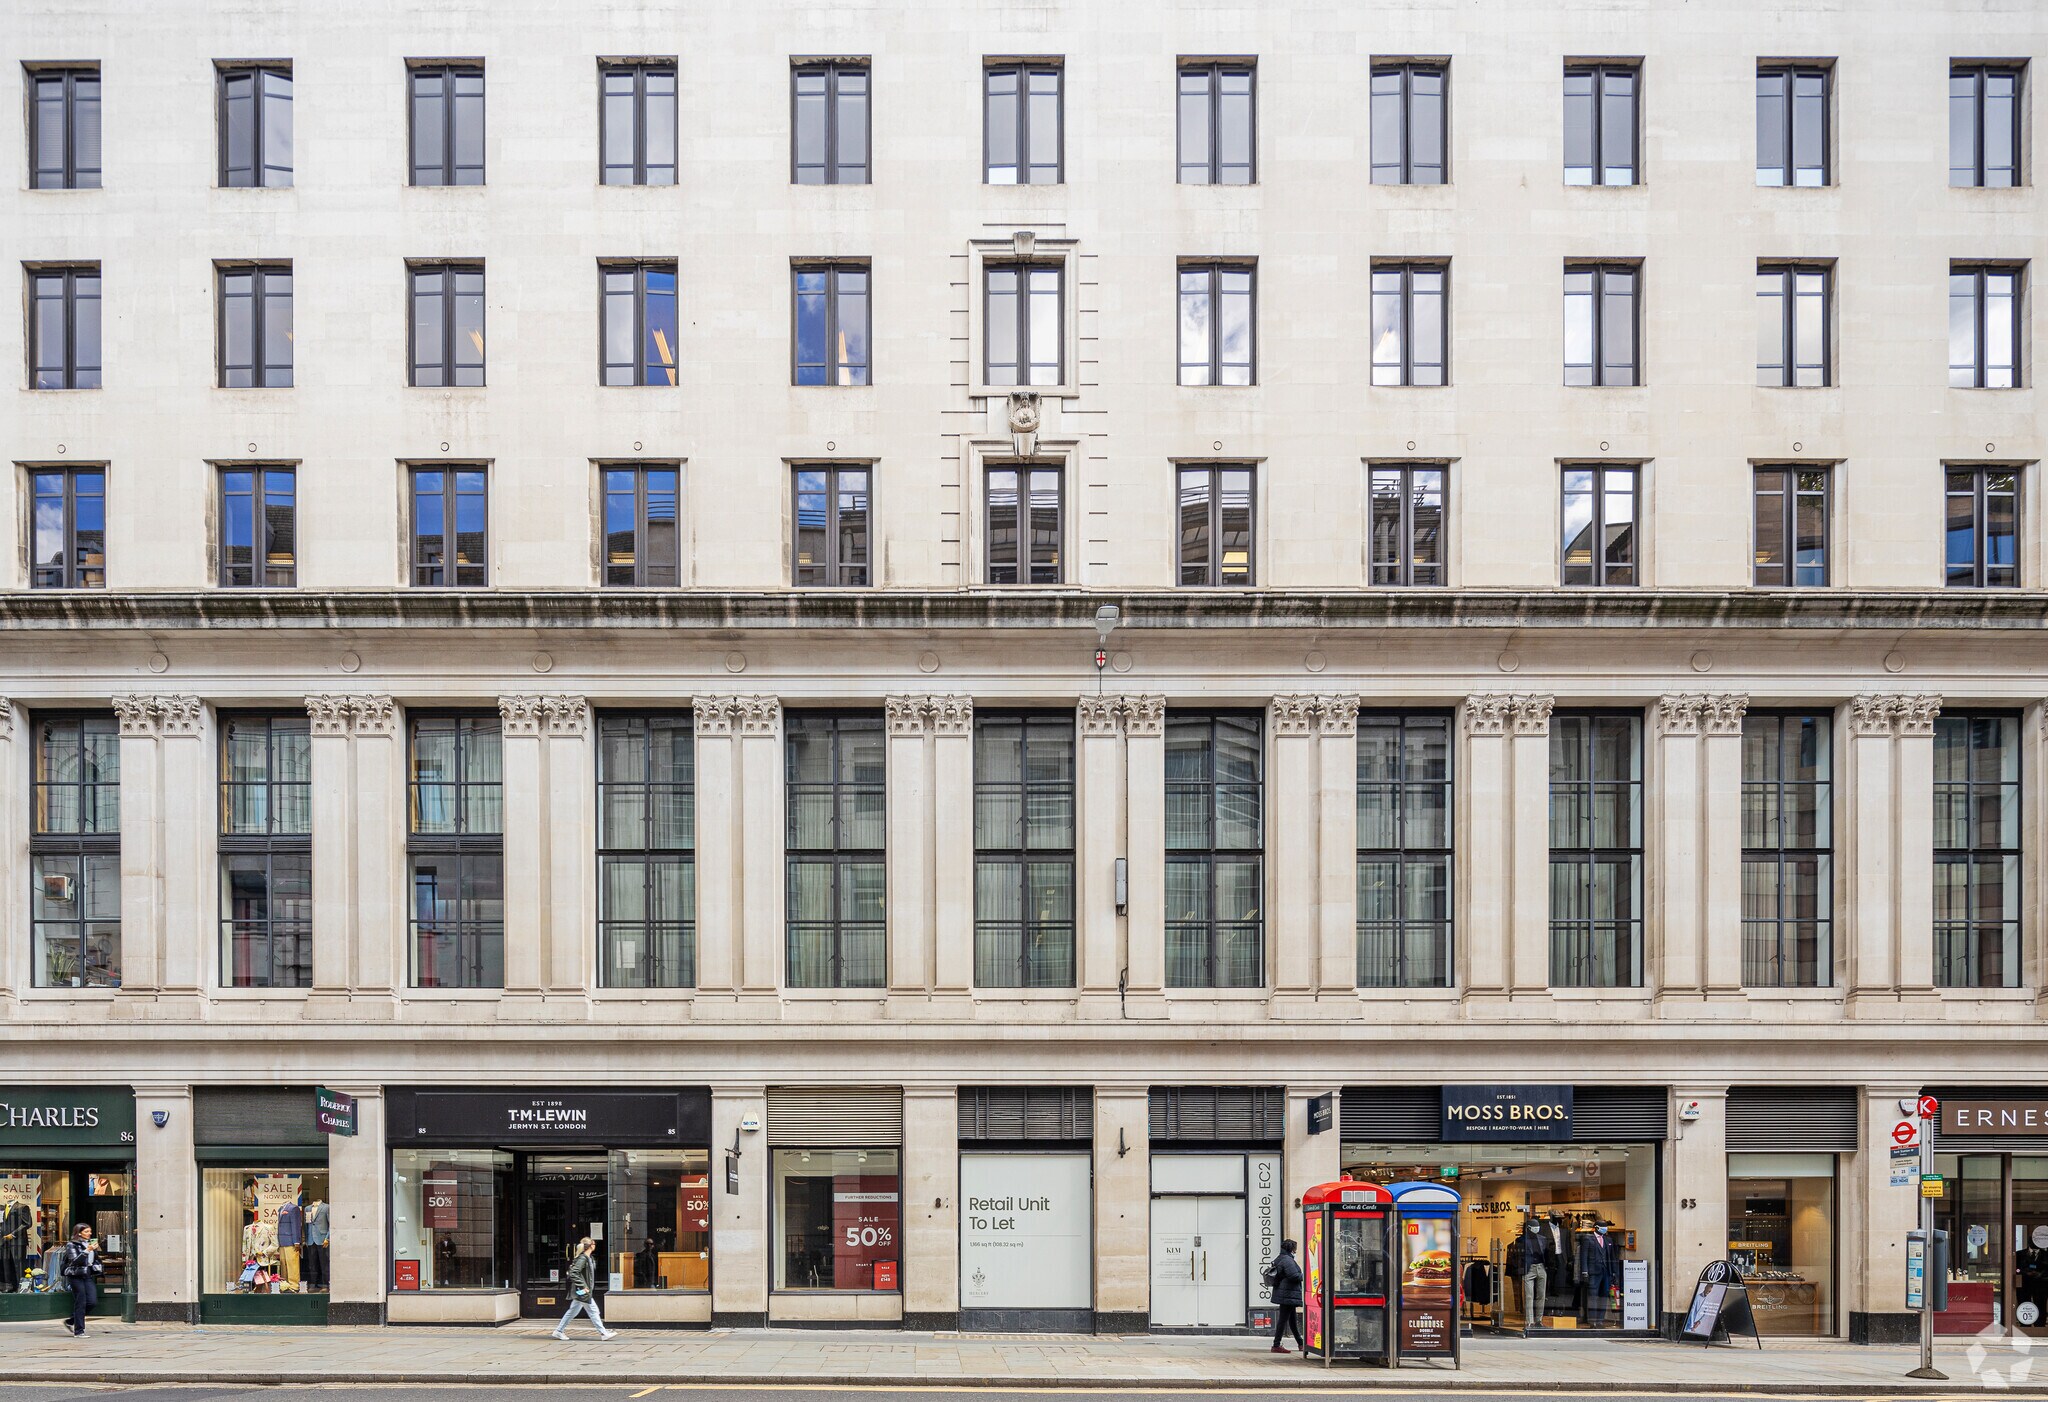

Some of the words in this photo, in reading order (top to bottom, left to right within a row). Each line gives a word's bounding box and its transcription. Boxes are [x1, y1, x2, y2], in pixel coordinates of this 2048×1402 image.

[320, 1096, 351, 1112] RODERICK
[1920, 1099, 1931, 1114] K
[1447, 1105, 1504, 1120] MOSS
[1509, 1105, 1569, 1120] BROS.
[321, 1113, 350, 1128] CHARLES
[120, 1131, 134, 1142] 86
[1258, 1162, 1271, 1189] EC2
[3, 1184, 32, 1193] SALE
[263, 1184, 293, 1193] SALE
[428, 1197, 452, 1207] 50%
[687, 1200, 708, 1211] 50%
[969, 1196, 1013, 1211] Retail
[1018, 1196, 1050, 1211] Unit
[1681, 1198, 1697, 1209] 83
[263, 1209, 278, 1218] SA
[969, 1216, 988, 1230] To
[992, 1216, 1015, 1230] Let
[845, 1227, 892, 1247] 50%
[1258, 1193, 1274, 1276] Cheapside,
[1258, 1282, 1271, 1300] 84
[1408, 1320, 1445, 1328] CLUBHOUSE
